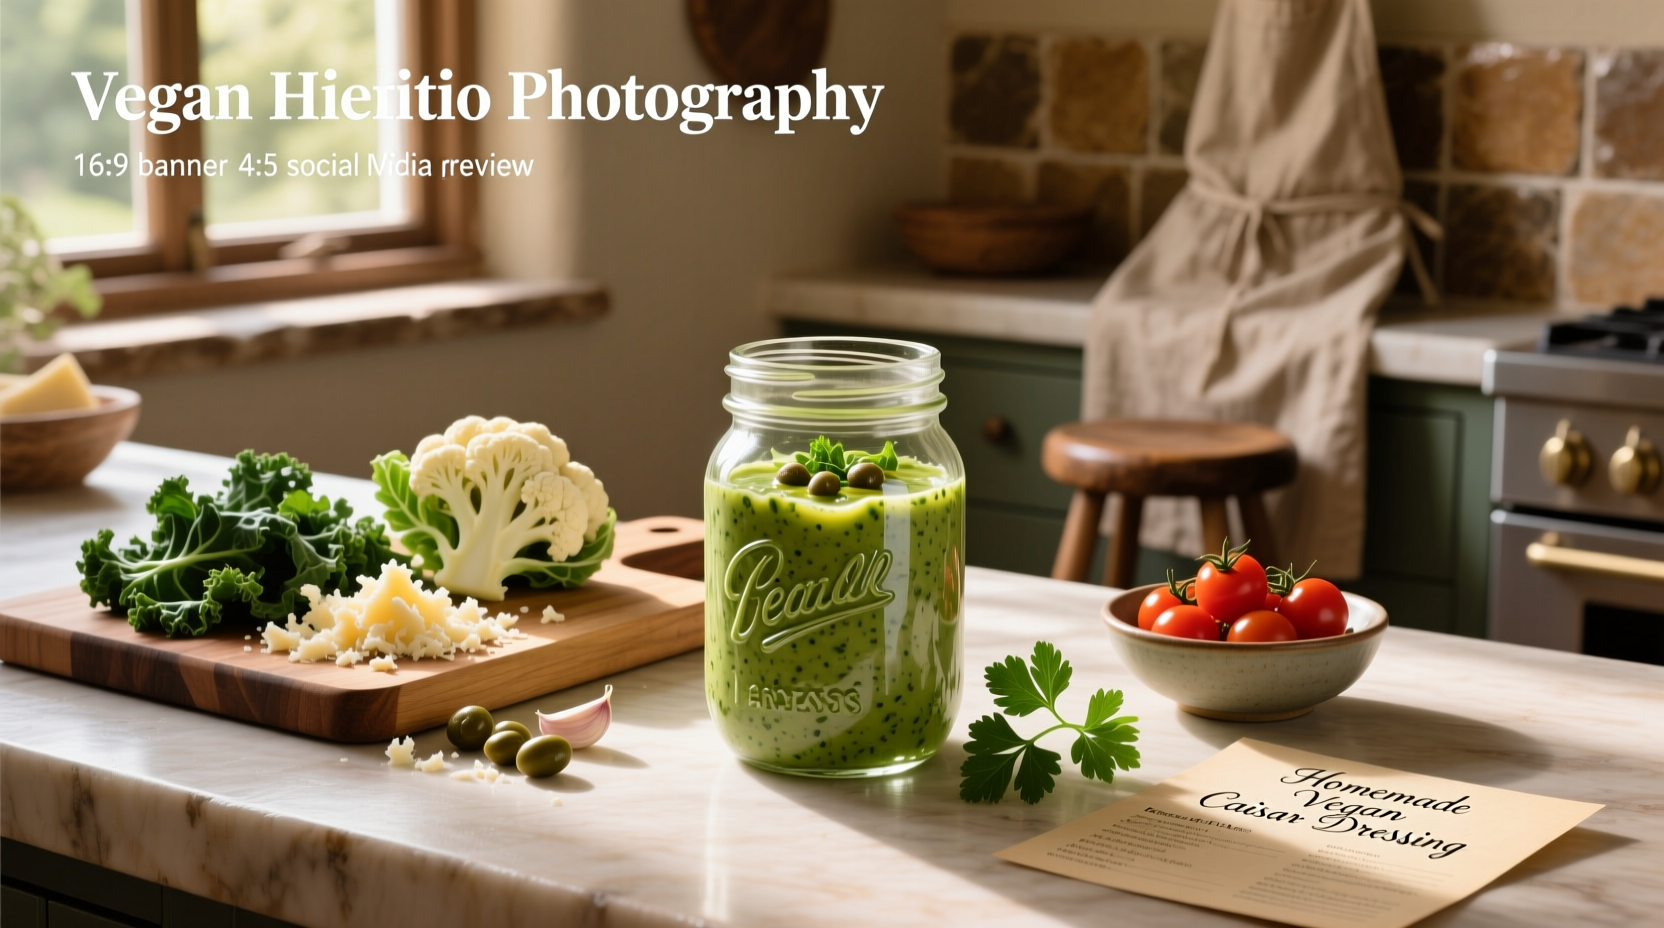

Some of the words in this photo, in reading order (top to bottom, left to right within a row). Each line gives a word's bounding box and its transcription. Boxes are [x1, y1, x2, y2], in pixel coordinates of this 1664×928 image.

[1280, 767, 1471, 815] Homemade
[1293, 789, 1407, 822] Vegan
[1199, 791, 1305, 824] Caisar
[1311, 813, 1467, 860] Dressing
